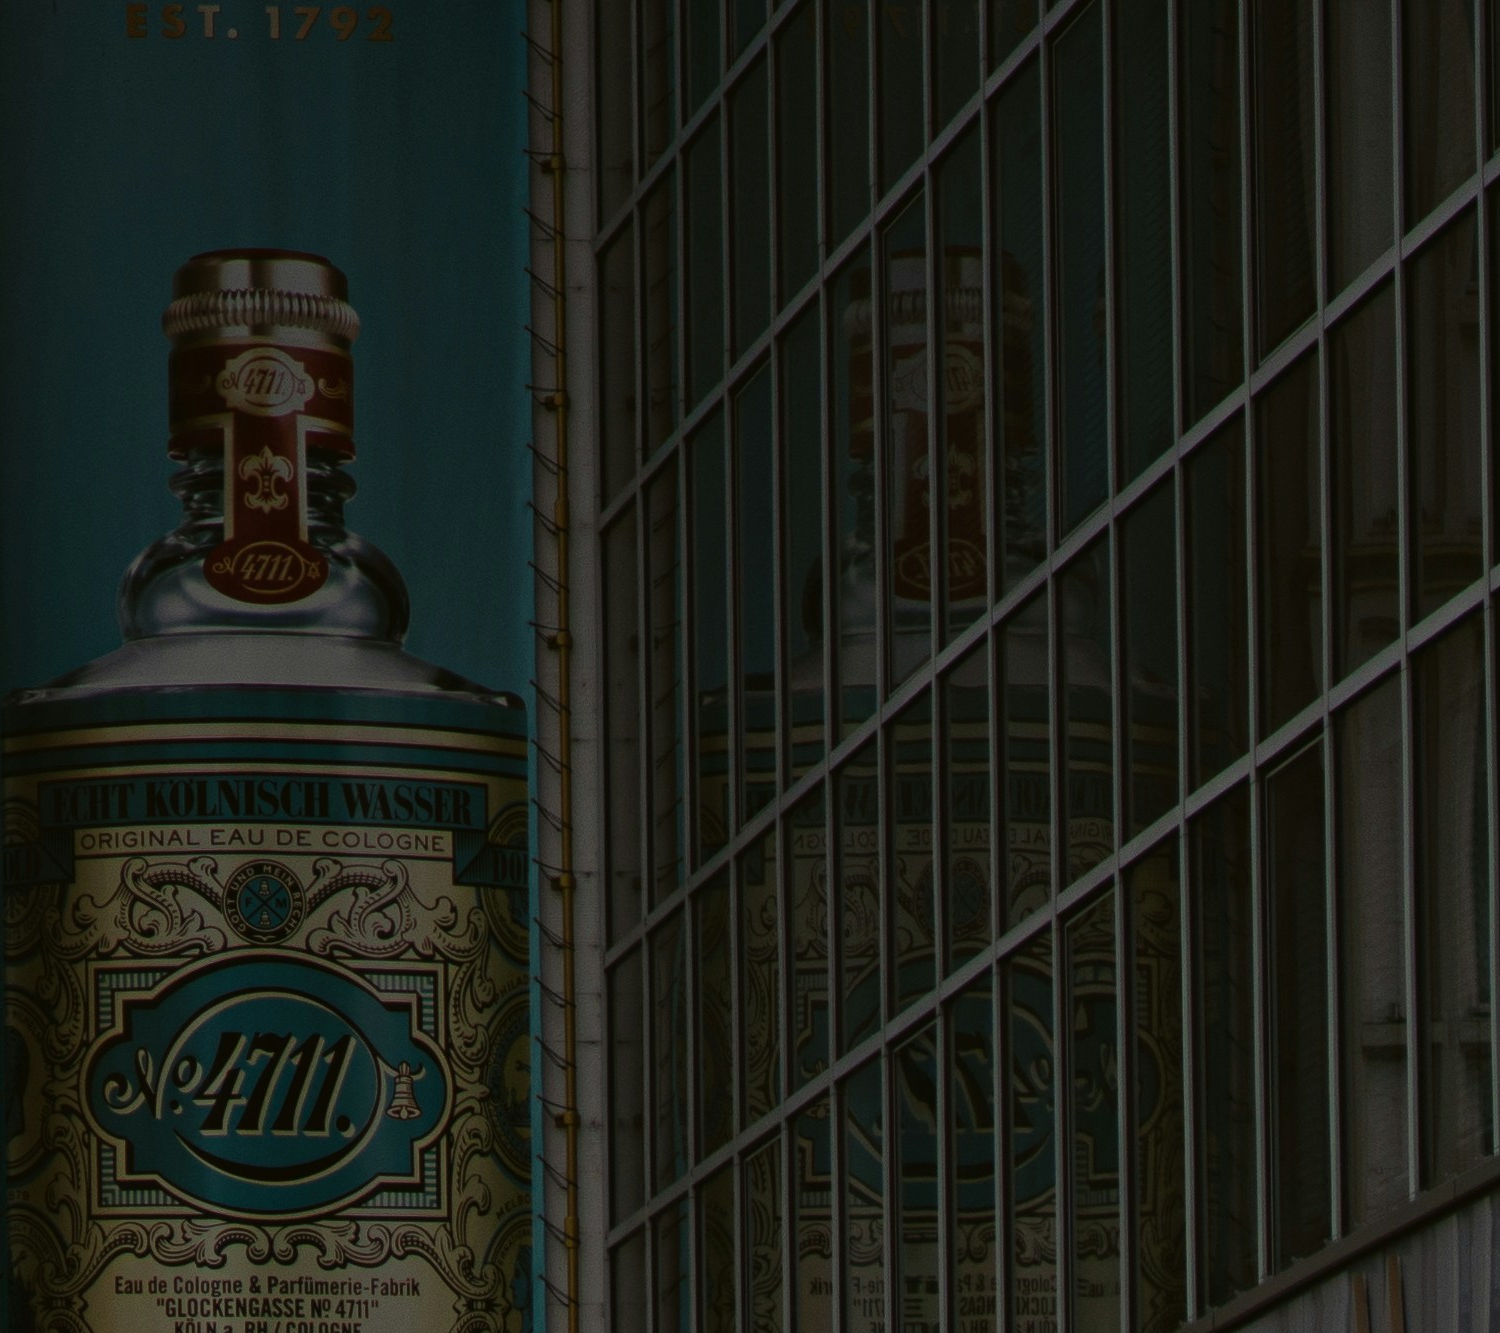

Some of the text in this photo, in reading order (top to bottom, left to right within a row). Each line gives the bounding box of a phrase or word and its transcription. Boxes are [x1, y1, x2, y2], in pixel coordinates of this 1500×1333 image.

[126, 4, 394, 41] EST. 1792
[53, 778, 474, 826] ECHT KÖLNISCH WASSER
[80, 828, 445, 852] ORIGINAL EAU DE COLOGNE
[115, 1275, 421, 1298] Eau de Cologne & Parfümerie-Fabrik
